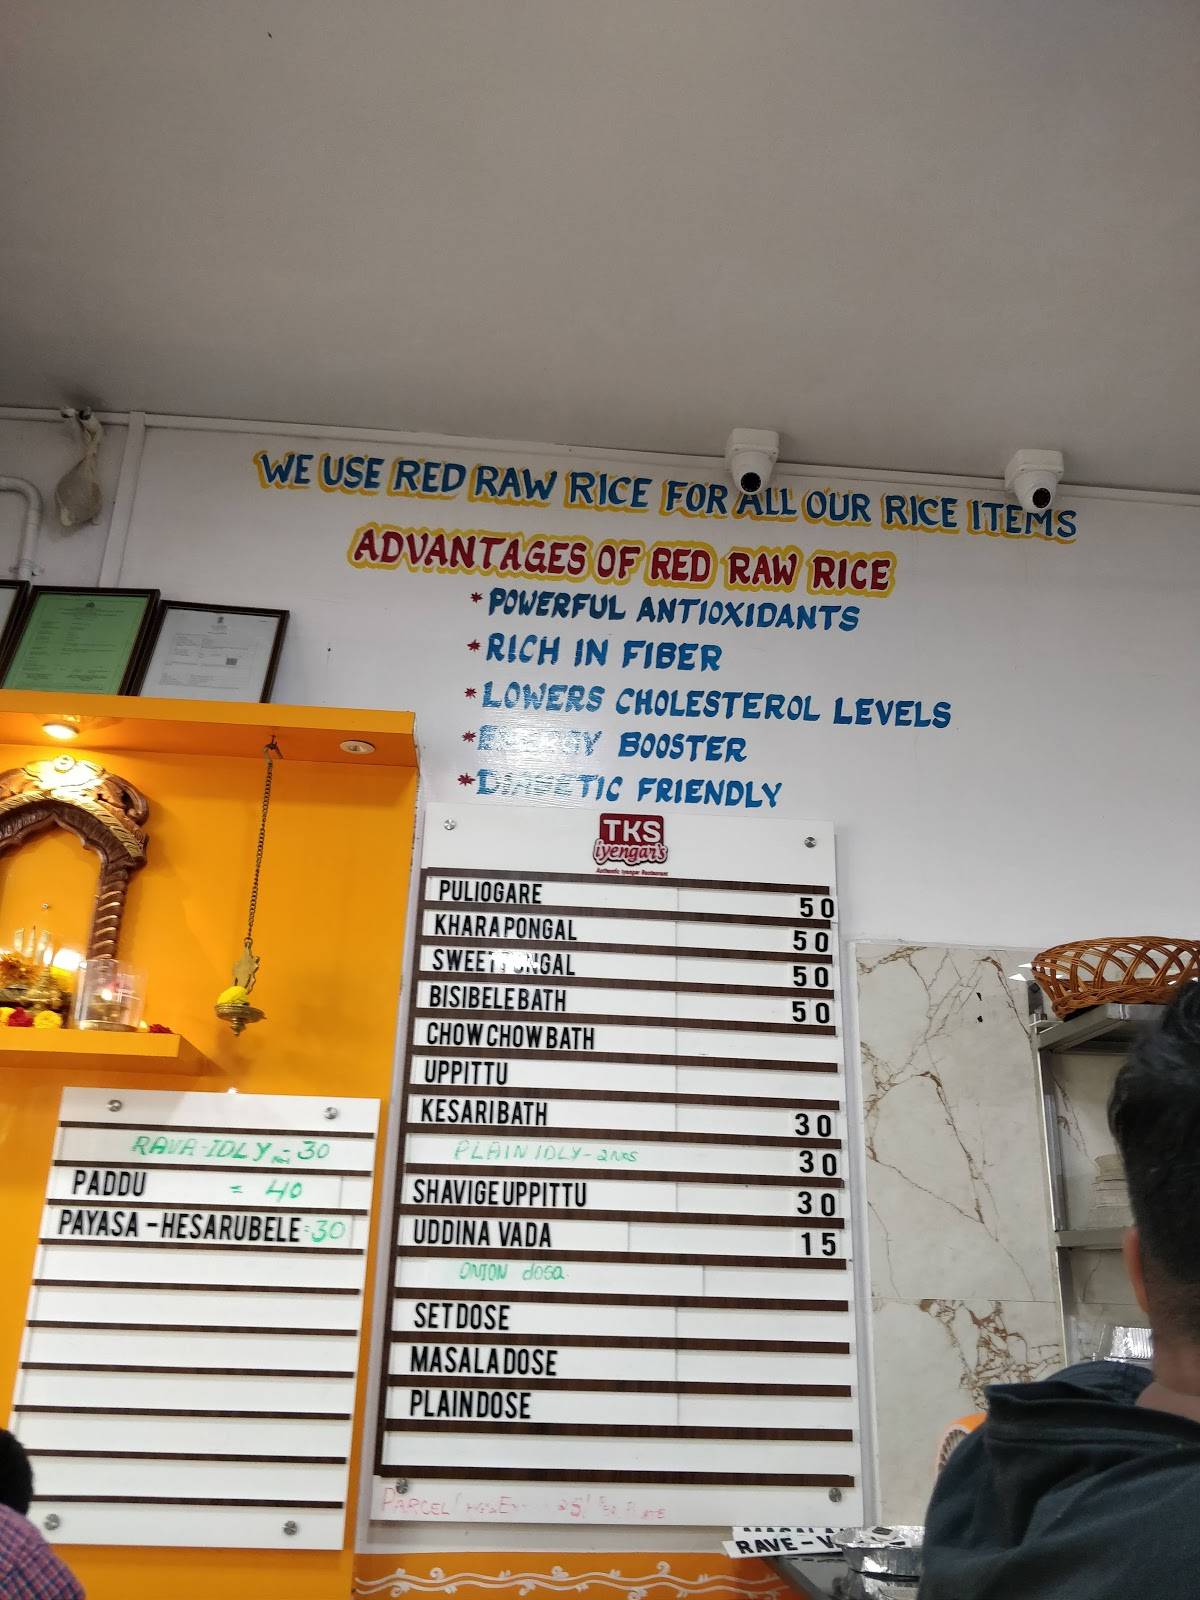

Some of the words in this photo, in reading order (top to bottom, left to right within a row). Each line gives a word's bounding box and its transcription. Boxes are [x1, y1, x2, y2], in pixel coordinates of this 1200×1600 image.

[259, 453, 314, 484] WE
[323, 455, 385, 489] USE
[393, 459, 466, 493] RED
[475, 465, 558, 500] RAW
[568, 470, 653, 508] RICE
[665, 479, 729, 514] FOR
[736, 486, 798, 516] ALL
[806, 490, 871, 523] OUR
[885, 495, 958, 528] RICE
[972, 501, 1077, 538] ITEMS
[353, 528, 587, 576] ADVANTAGES
[597, 545, 641, 579] OF
[651, 547, 712, 584] RED
[728, 552, 798, 587] RAW
[811, 556, 891, 592] RICE
[487, 588, 626, 620] POWERFUL
[636, 596, 861, 632] ANTIOXIDANTS
[486, 632, 561, 666] RICH
[573, 638, 609, 667] IN
[621, 640, 723, 672] FIBER
[482, 681, 606, 713] LOWERS
[615, 687, 821, 723] CHOLESTEROL
[832, 697, 952, 729] LEVELS
[617, 731, 748, 764] BOOSTER
[636, 777, 783, 808] FRIENDLY
[602, 819, 662, 843] TKS
[439, 879, 543, 905] PULIOGARE
[799, 897, 835, 918] 50
[792, 929, 829, 952] 50
[792, 965, 829, 988] 50
[791, 1000, 830, 1024] 50
[424, 1059, 508, 1086] UPPITTU
[794, 1112, 832, 1137] 30
[799, 1150, 837, 1177] 30
[72, 1169, 147, 1197] PADDU
[264, 1179, 302, 1202] 40
[797, 1191, 836, 1217] 30
[413, 1218, 491, 1246] UDDINA
[498, 1221, 552, 1249] VADA
[800, 1232, 837, 1257] 15
[735, 1536, 798, 1555] RAVE
